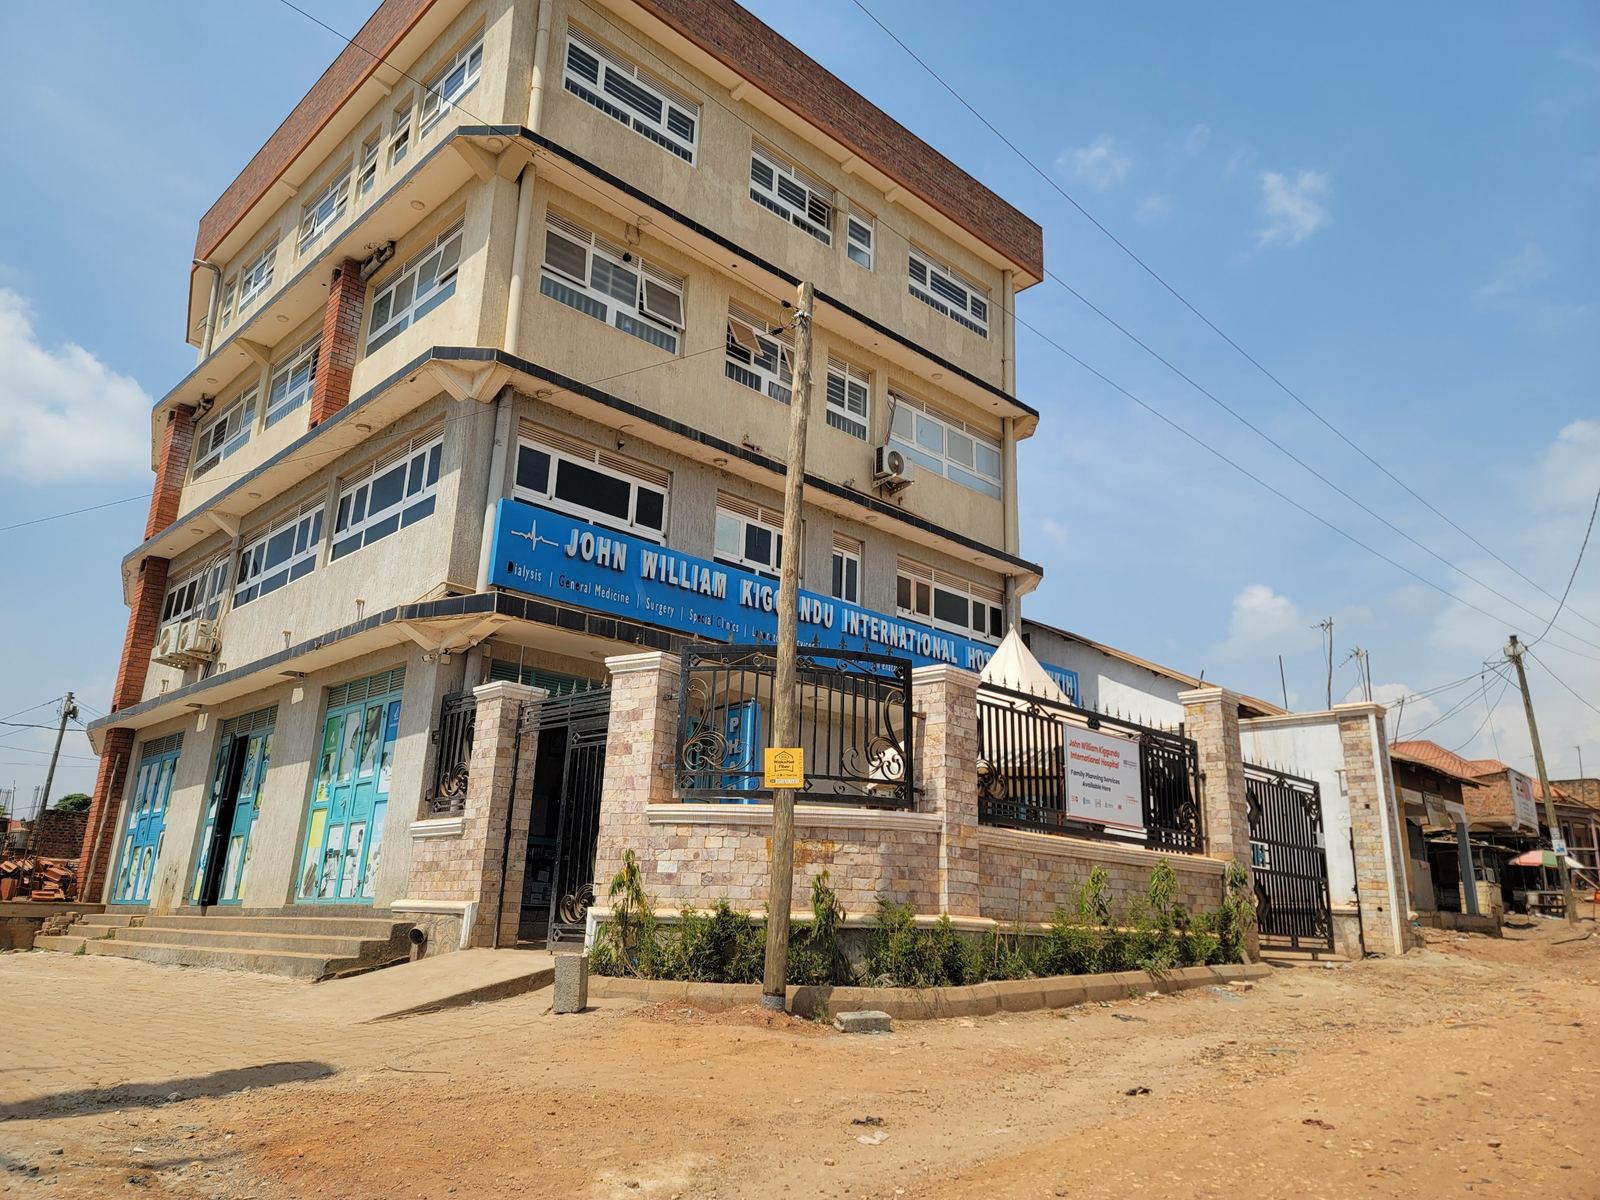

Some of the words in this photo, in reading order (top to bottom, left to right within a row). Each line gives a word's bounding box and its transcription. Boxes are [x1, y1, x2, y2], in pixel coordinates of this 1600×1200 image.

[507, 560, 542, 581] Dialysis
[559, 575, 592, 594] General
[594, 583, 630, 604] Medicine
[645, 597, 675, 618] Surgery
[565, 528, 627, 572] JOHN
[641, 550, 727, 599] WILLIAM
[740, 579, 834, 628] KIGNDU
[841, 608, 958, 664] INTERNATIONAL
[1069, 739, 1081, 749] John
[1081, 742, 1098, 753] William
[1070, 751, 1101, 765] International
